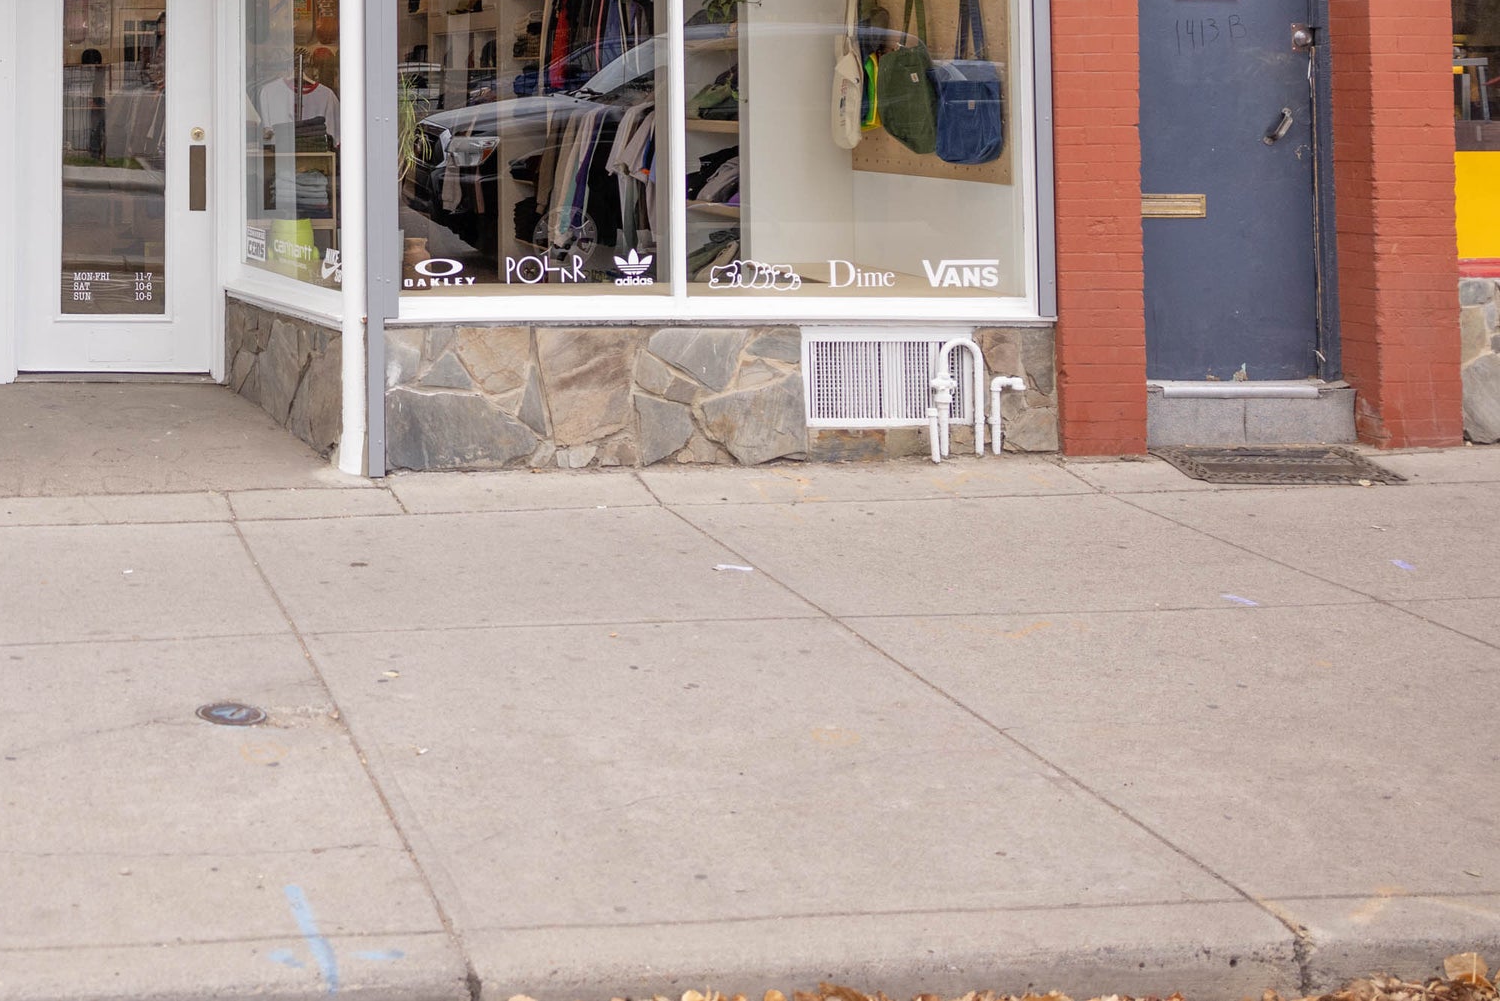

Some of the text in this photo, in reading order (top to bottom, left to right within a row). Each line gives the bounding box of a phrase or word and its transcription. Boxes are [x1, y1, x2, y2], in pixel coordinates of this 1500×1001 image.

[1228, 14, 1247, 40] B
[73, 272, 153, 281] MON-FRI 11-7
[827, 260, 896, 288] Dime
[922, 259, 1000, 288] VANS
[73, 282, 153, 291] SAT 10-6
[404, 276, 476, 288] OAKLEY
[615, 277, 653, 286] adidas
[73, 292, 153, 301] SUN 10-5
